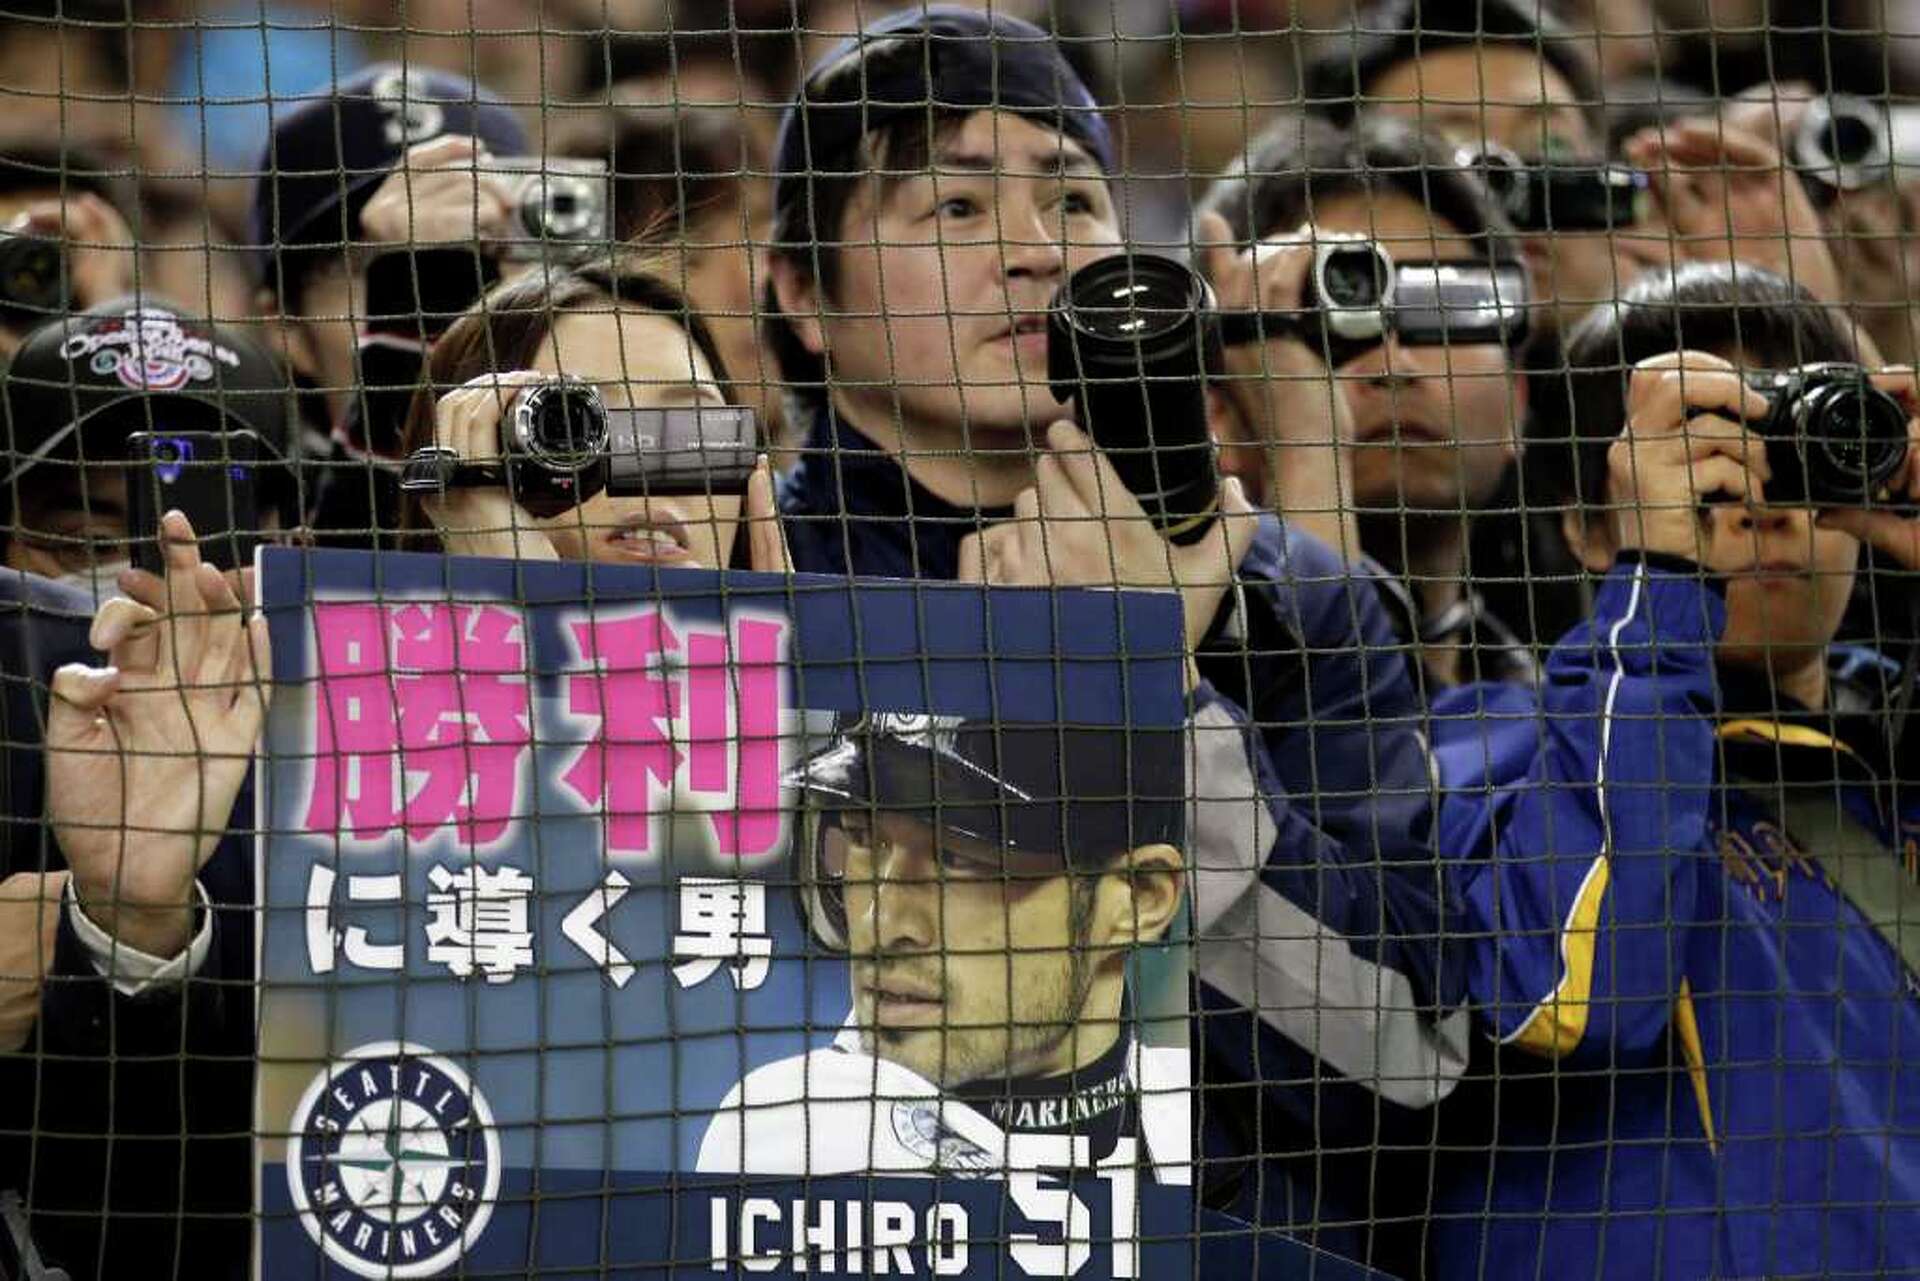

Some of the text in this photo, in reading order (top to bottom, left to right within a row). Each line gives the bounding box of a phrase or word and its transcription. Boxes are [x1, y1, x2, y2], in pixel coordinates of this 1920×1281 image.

[304, 600, 783, 854] 勝利
[306, 863, 772, 989] に導く男
[314, 1181, 475, 1257] MARINERS
[711, 1132, 1140, 1278] ICHIRO 51
